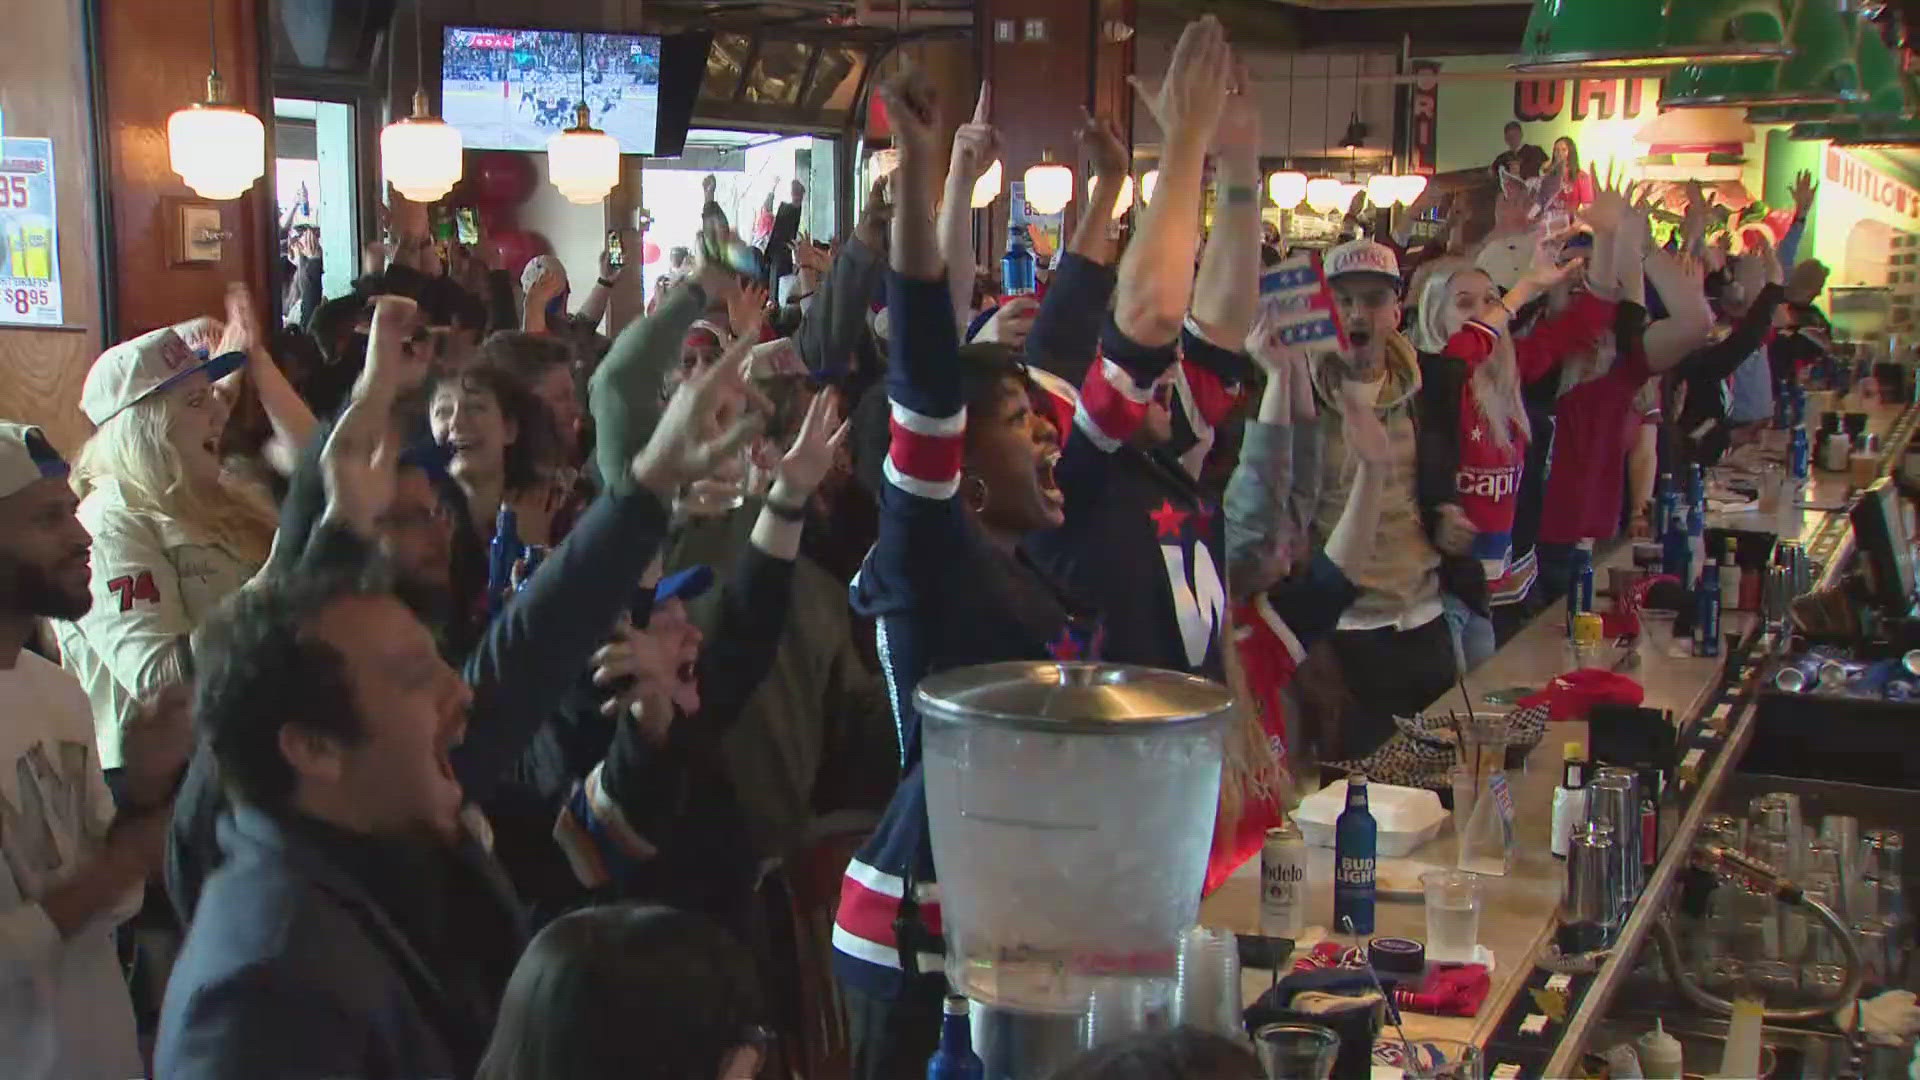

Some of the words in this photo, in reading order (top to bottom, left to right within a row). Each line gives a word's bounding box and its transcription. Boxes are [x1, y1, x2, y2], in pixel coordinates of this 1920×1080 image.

[476, 39, 511, 47] GOAL
[1514, 78, 1660, 122] WHI
[107, 570, 160, 612] 74
[1342, 857, 1375, 871] BUD
